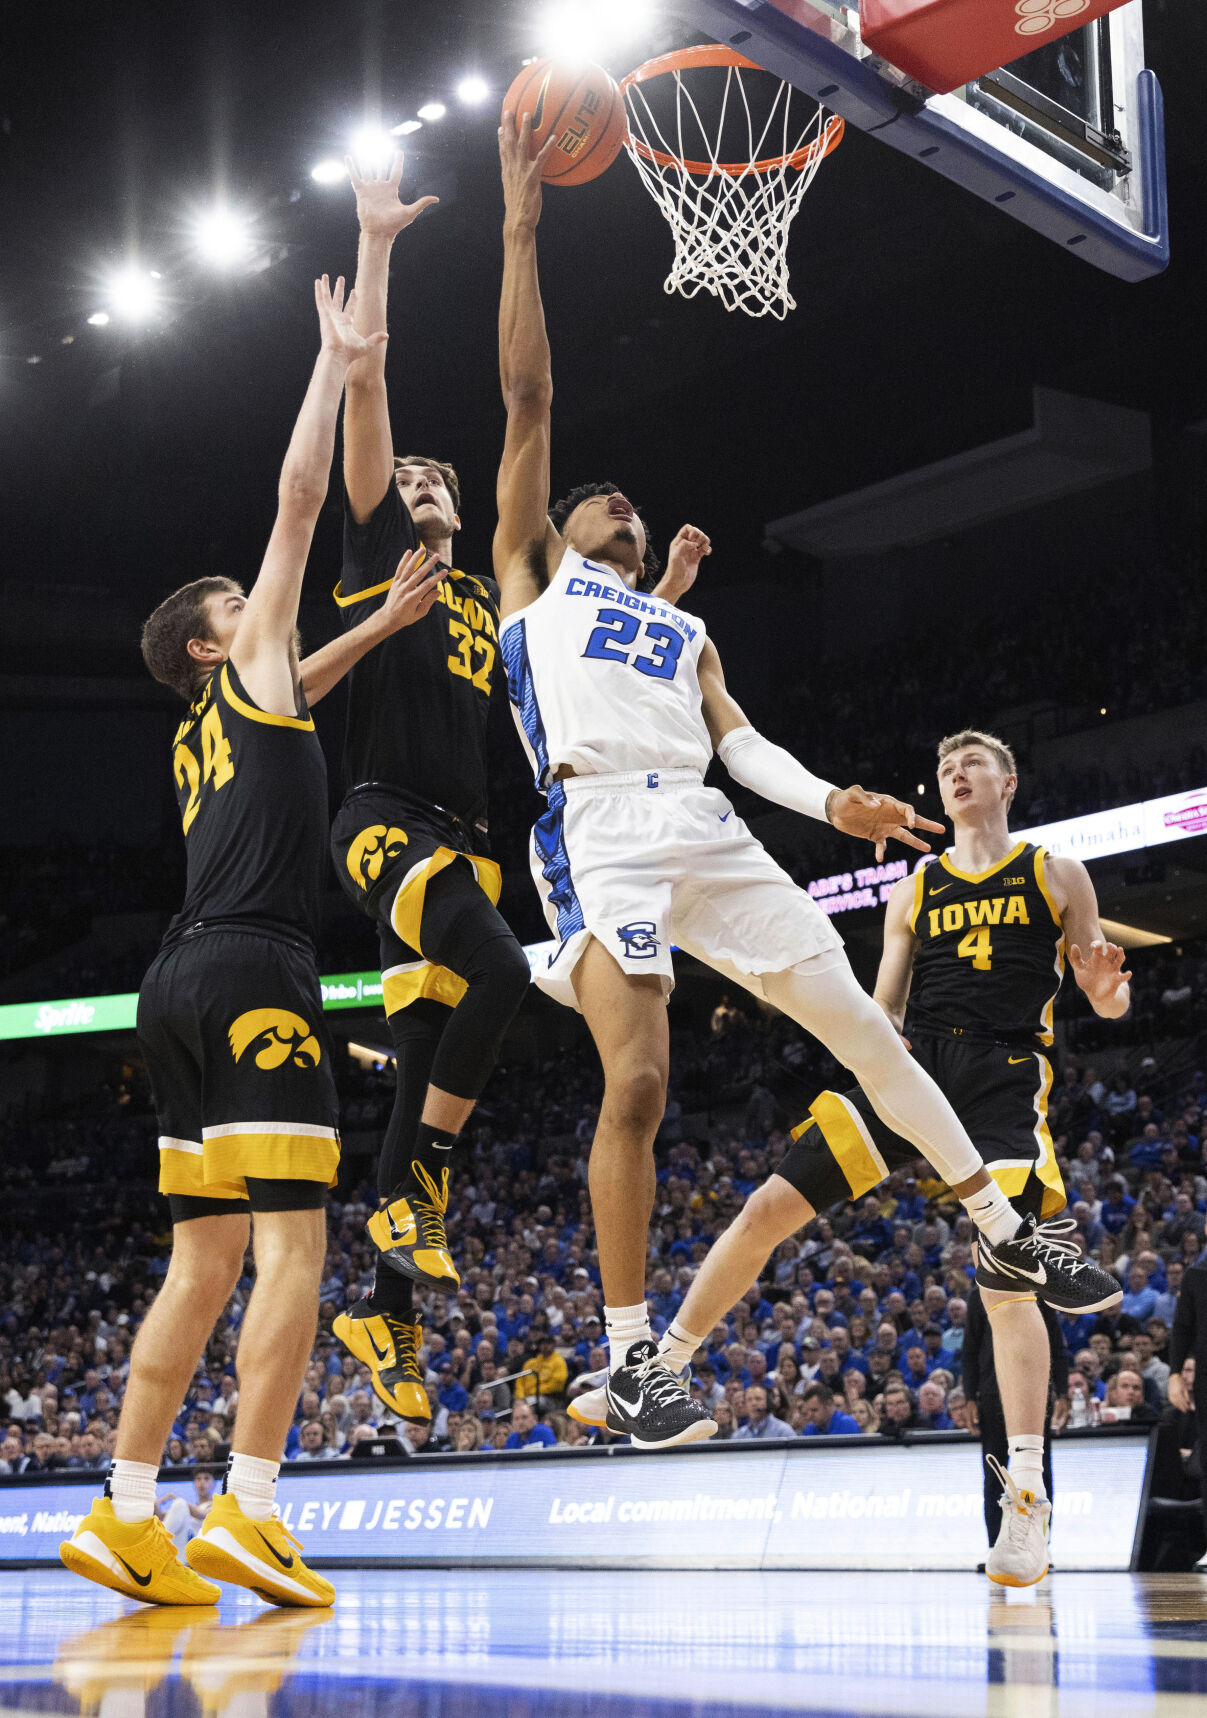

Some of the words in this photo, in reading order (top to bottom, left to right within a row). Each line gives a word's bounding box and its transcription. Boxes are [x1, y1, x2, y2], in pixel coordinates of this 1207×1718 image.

[556, 88, 601, 155] ELITE
[565, 577, 697, 643] CREIGHTON
[447, 618, 495, 697] 32
[580, 608, 685, 680] 23
[173, 702, 235, 837] 24
[1070, 820, 1141, 849] Omaha
[854, 859, 908, 888] TRASH
[815, 888, 878, 915] ERVICE,
[928, 895, 1030, 938] IOWA
[957, 926, 993, 971] 4
[34, 1001, 96, 1033] Sprite
[365, 1496, 494, 1531] JESSEN
[549, 1496, 615, 1524] Local
[617, 1492, 783, 1524] commitment,
[791, 1488, 911, 1519] National
